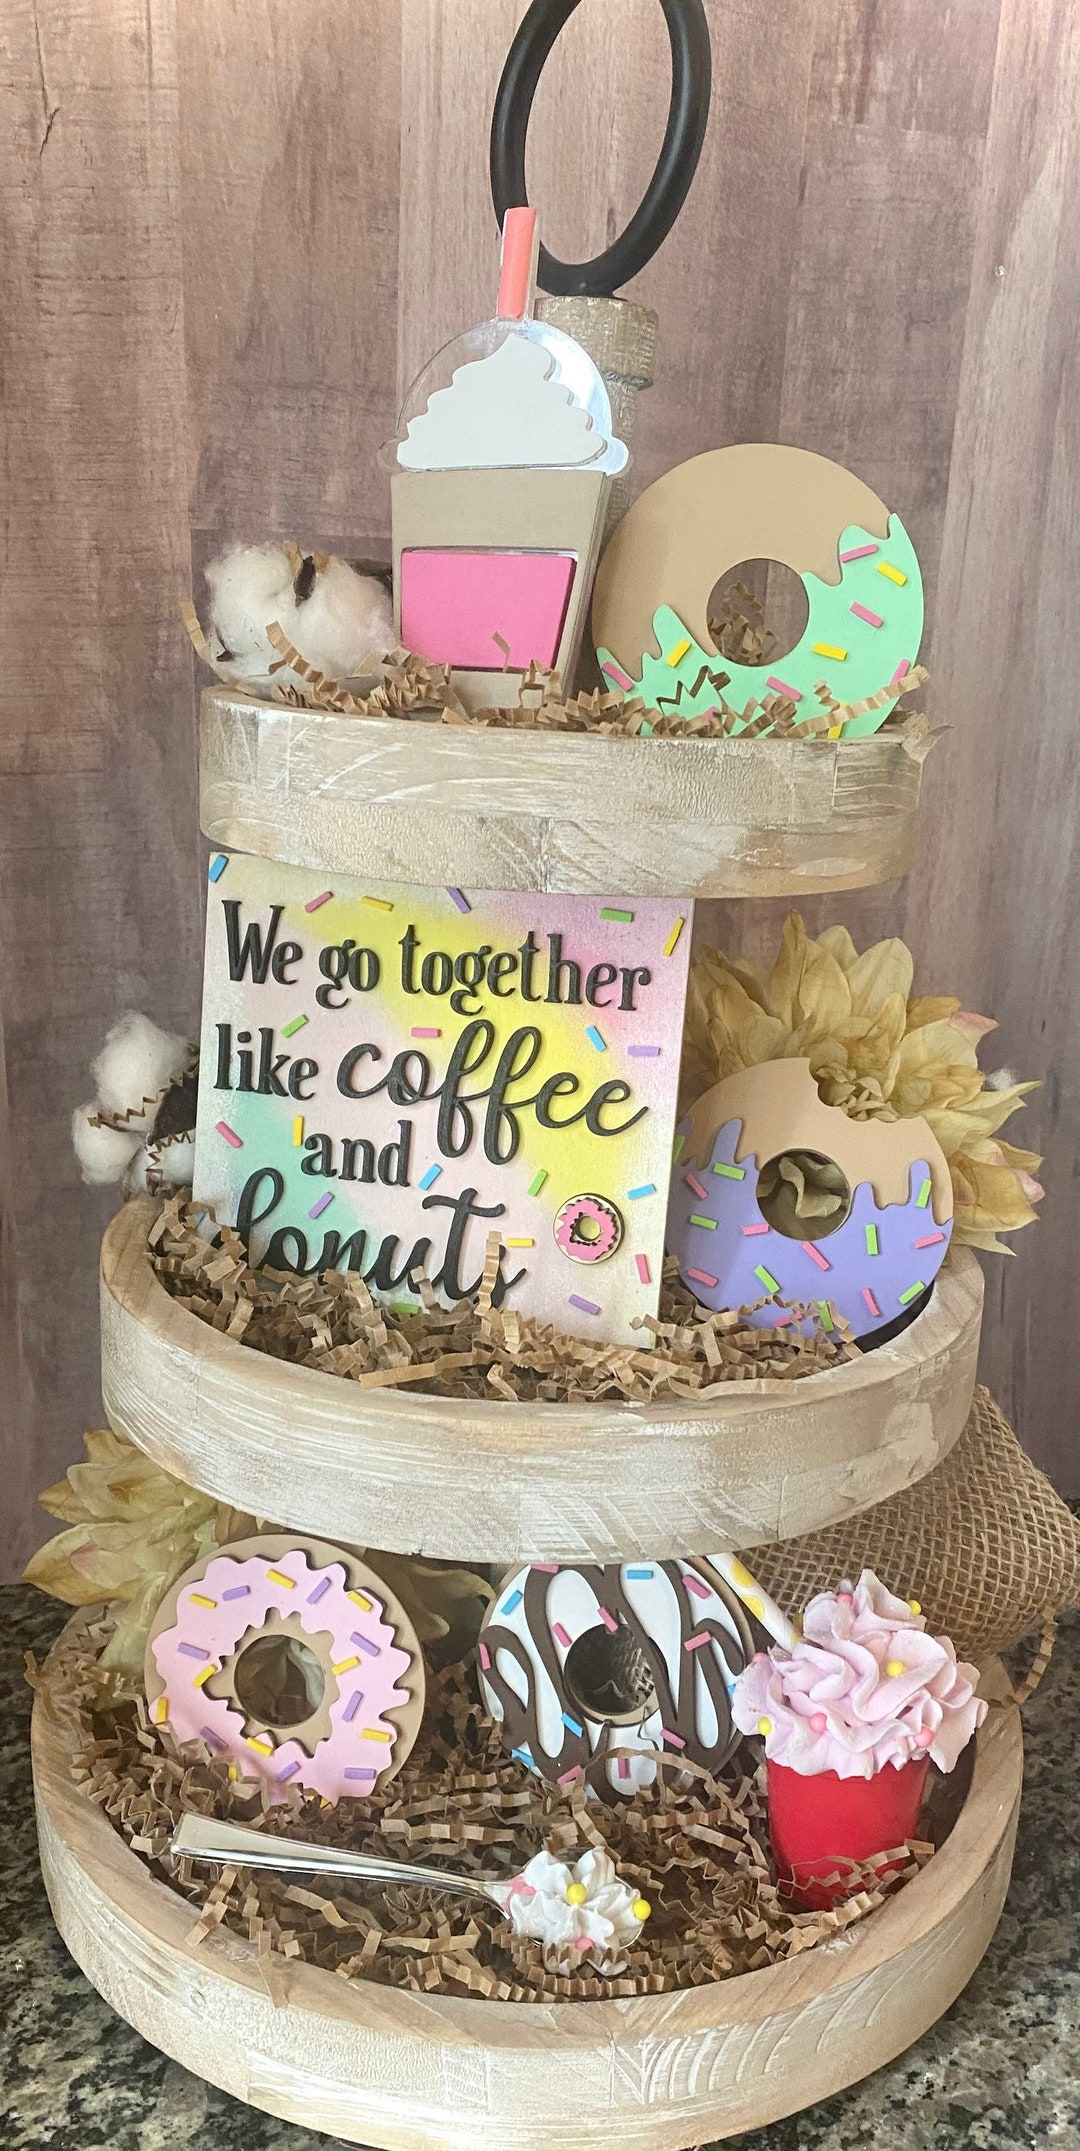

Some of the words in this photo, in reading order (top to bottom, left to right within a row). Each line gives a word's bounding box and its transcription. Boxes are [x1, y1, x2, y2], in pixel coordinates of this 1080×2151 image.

[222, 900, 303, 986] We
[315, 939, 381, 1010] go
[398, 924, 651, 1016] together
[213, 1023, 319, 1101] like
[336, 1019, 649, 1166] coffee
[300, 1119, 412, 1188] and
